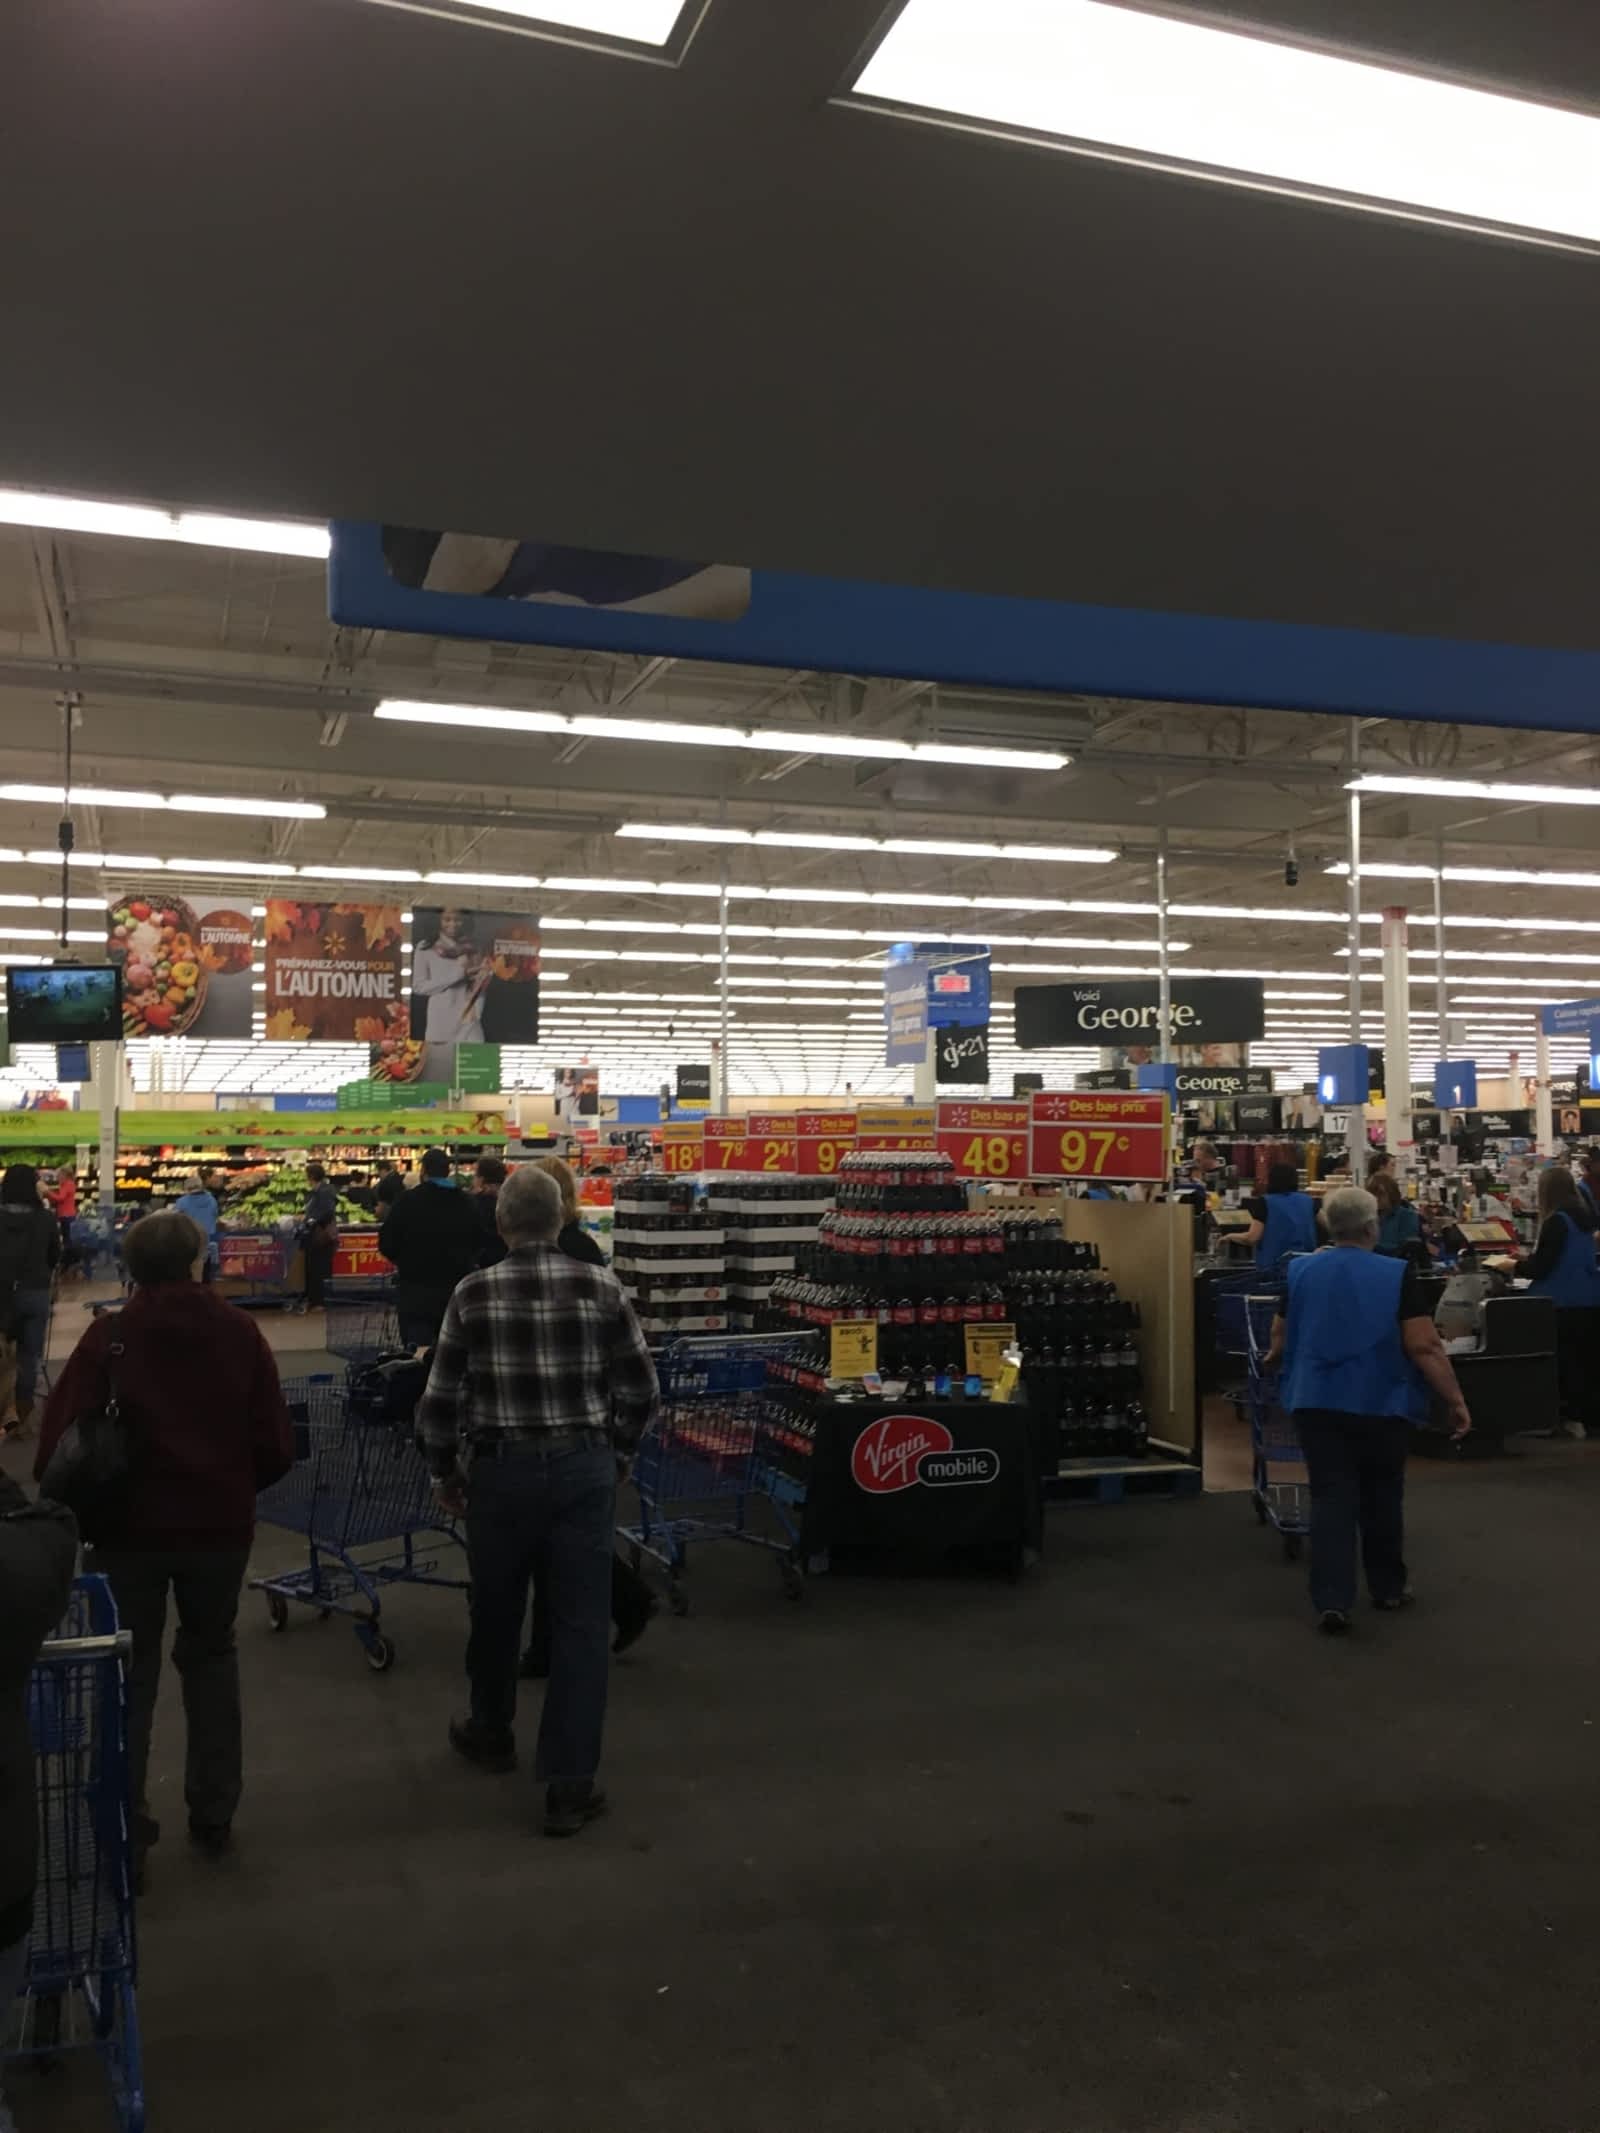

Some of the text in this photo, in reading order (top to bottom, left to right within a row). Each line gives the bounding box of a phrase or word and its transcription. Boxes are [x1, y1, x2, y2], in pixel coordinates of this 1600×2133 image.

[276, 958, 367, 971] PRÉPAREZ-VOUS
[276, 970, 396, 998] L'AUTOMNE
[1073, 989, 1101, 1002] Voici
[1175, 1075, 1245, 1096] George.
[1453, 1085, 1461, 1105] 1
[971, 1109, 992, 1121] Des
[993, 1109, 1013, 1121] bas
[1070, 1100, 1094, 1113] Des
[1096, 1100, 1120, 1113] bas
[1121, 1102, 1148, 1116] prix
[864, 1422, 931, 1482] Virgin
[928, 1457, 989, 1477] mobile
